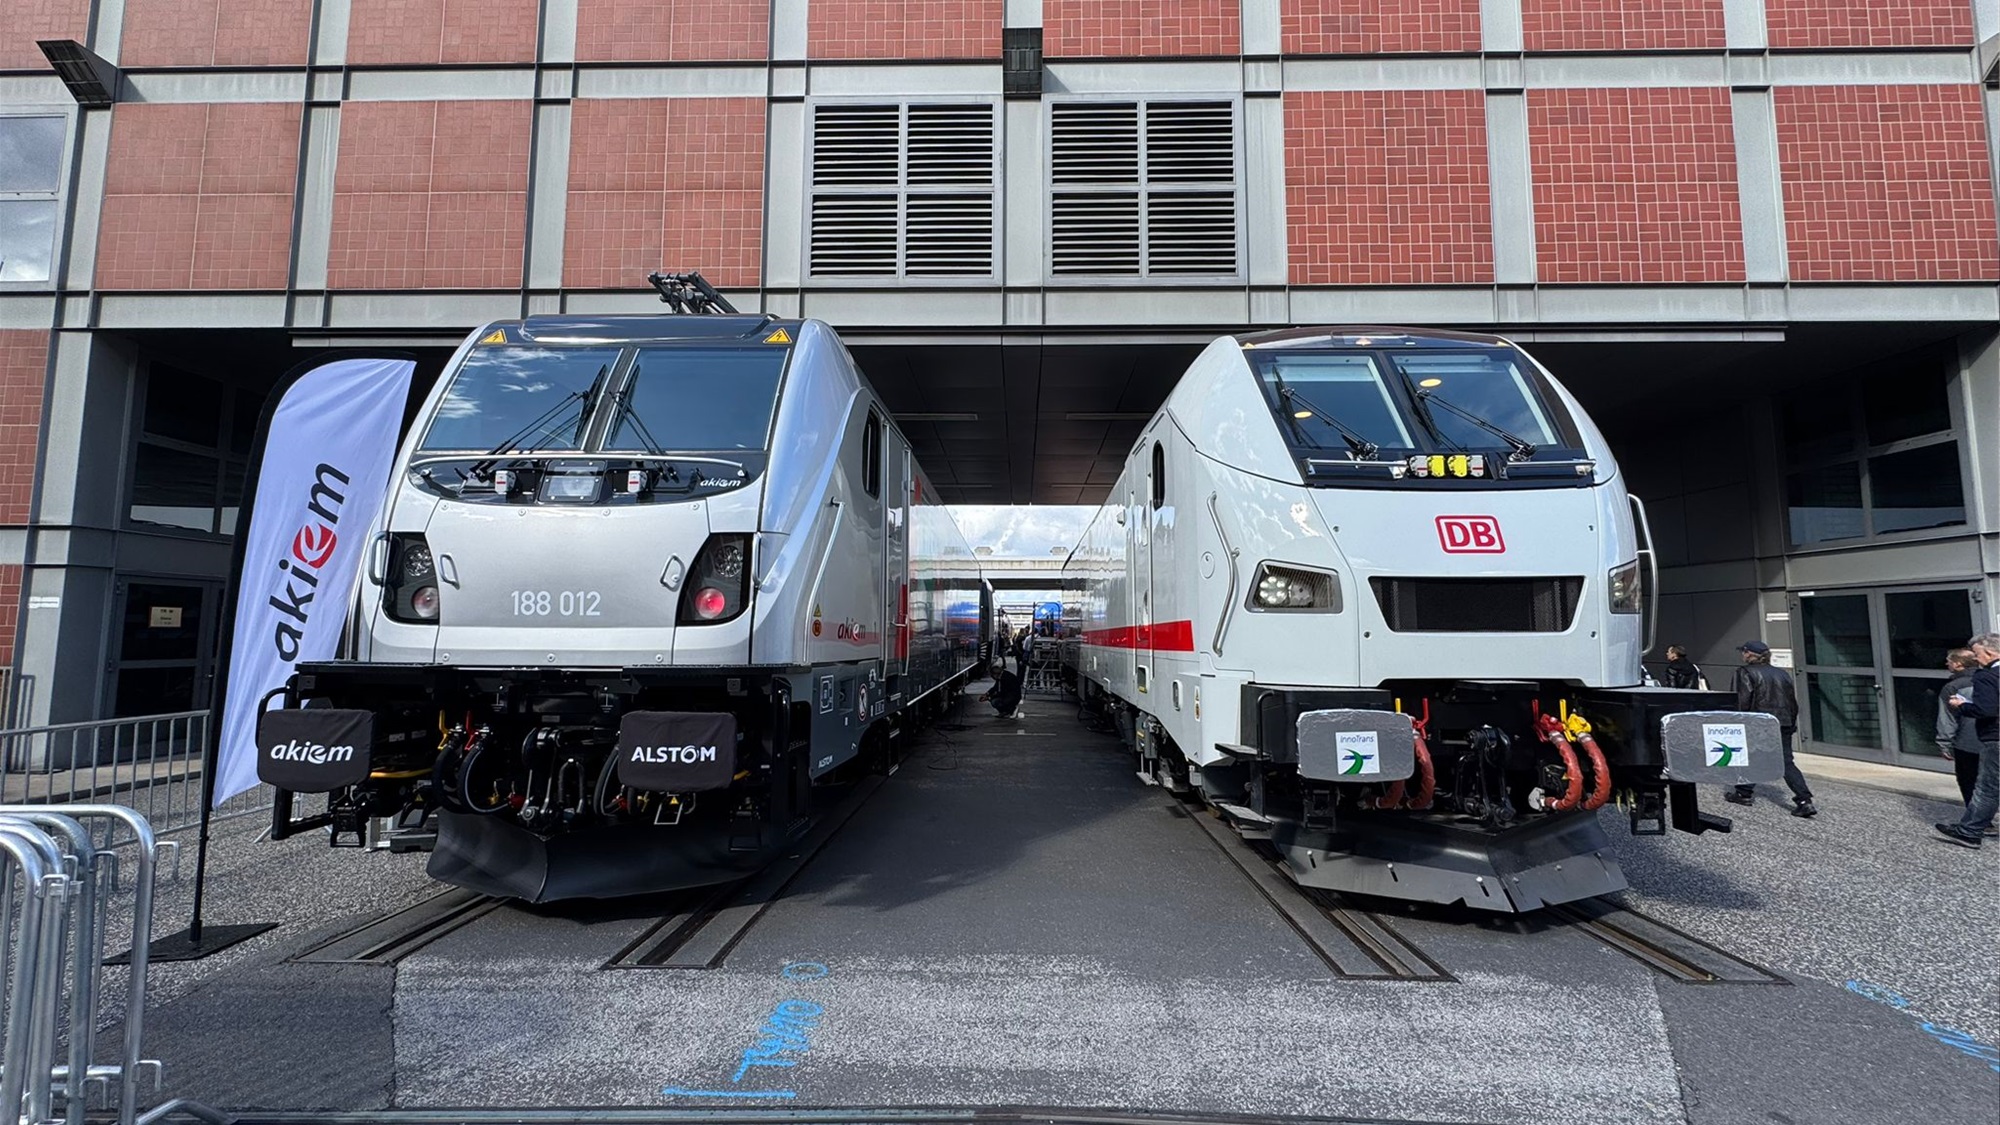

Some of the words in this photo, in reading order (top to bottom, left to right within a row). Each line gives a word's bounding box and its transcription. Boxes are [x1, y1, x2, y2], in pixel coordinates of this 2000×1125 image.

[1442, 520, 1498, 548] DB
[511, 590, 552, 616] 188
[559, 590, 602, 616] 012
[1340, 734, 1375, 743] InnoTrans
[1707, 726, 1742, 735] InnoTrans
[630, 745, 717, 764] ALSTOM
